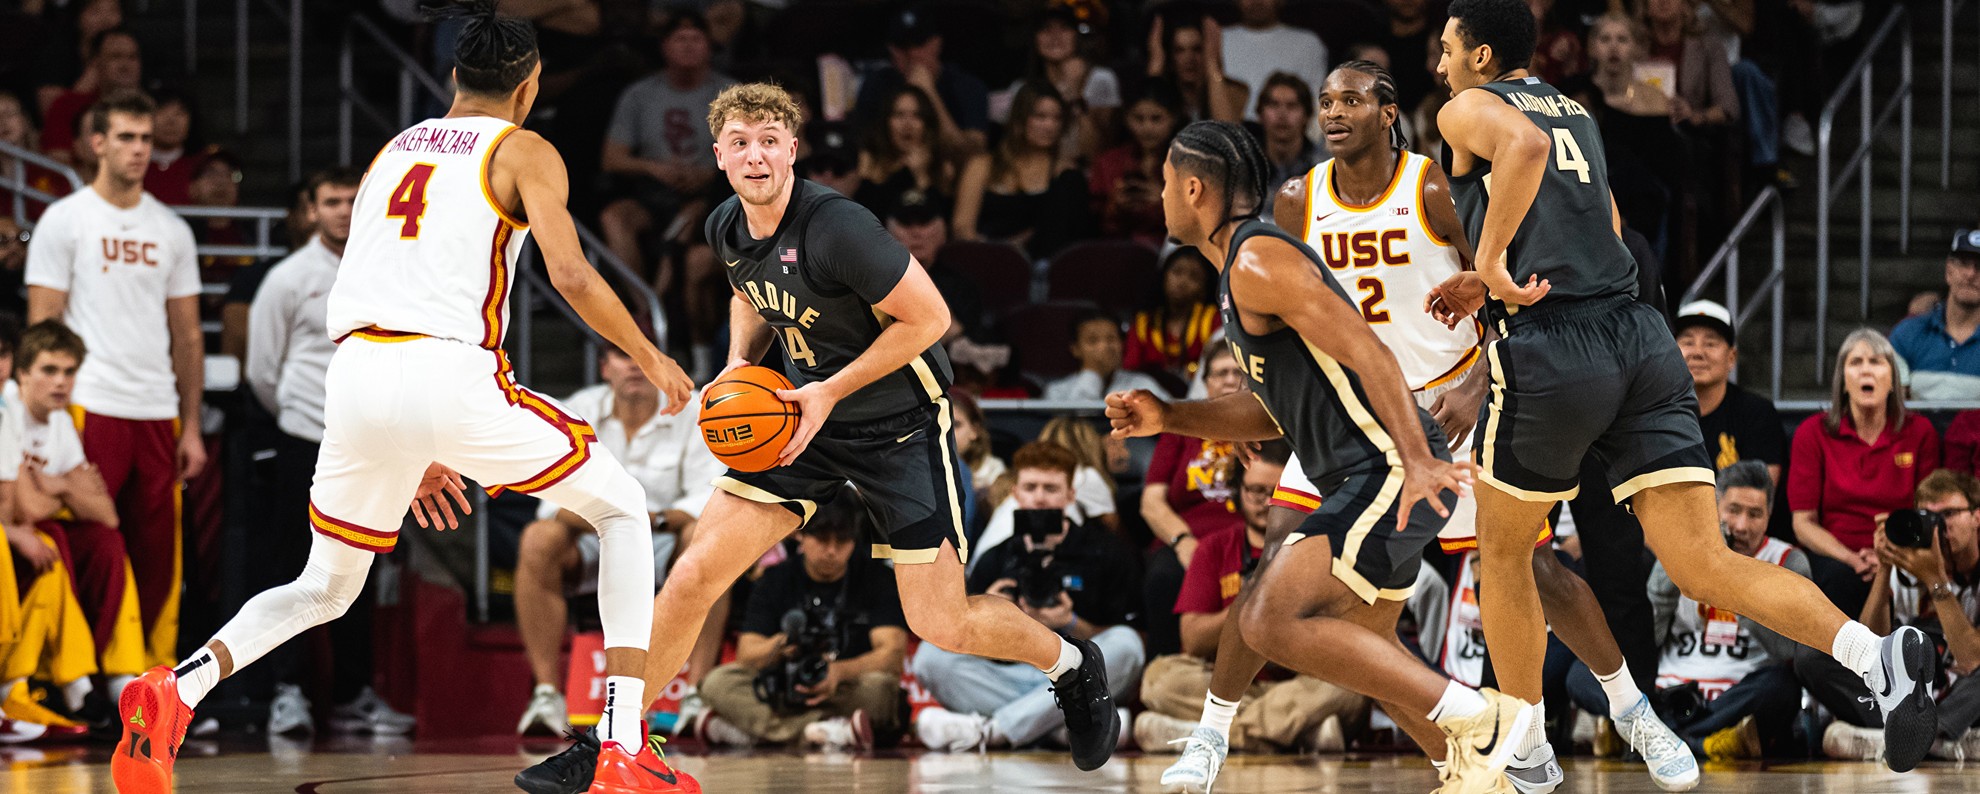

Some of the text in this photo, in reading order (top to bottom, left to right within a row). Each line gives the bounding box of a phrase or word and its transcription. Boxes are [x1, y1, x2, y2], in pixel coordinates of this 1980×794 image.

[1551, 127, 1591, 184] 4
[385, 161, 438, 240] 4
[101, 236, 159, 268] USC
[1320, 228, 1411, 271] USC
[1355, 276, 1392, 325] 2
[705, 423, 754, 444] ELITE
